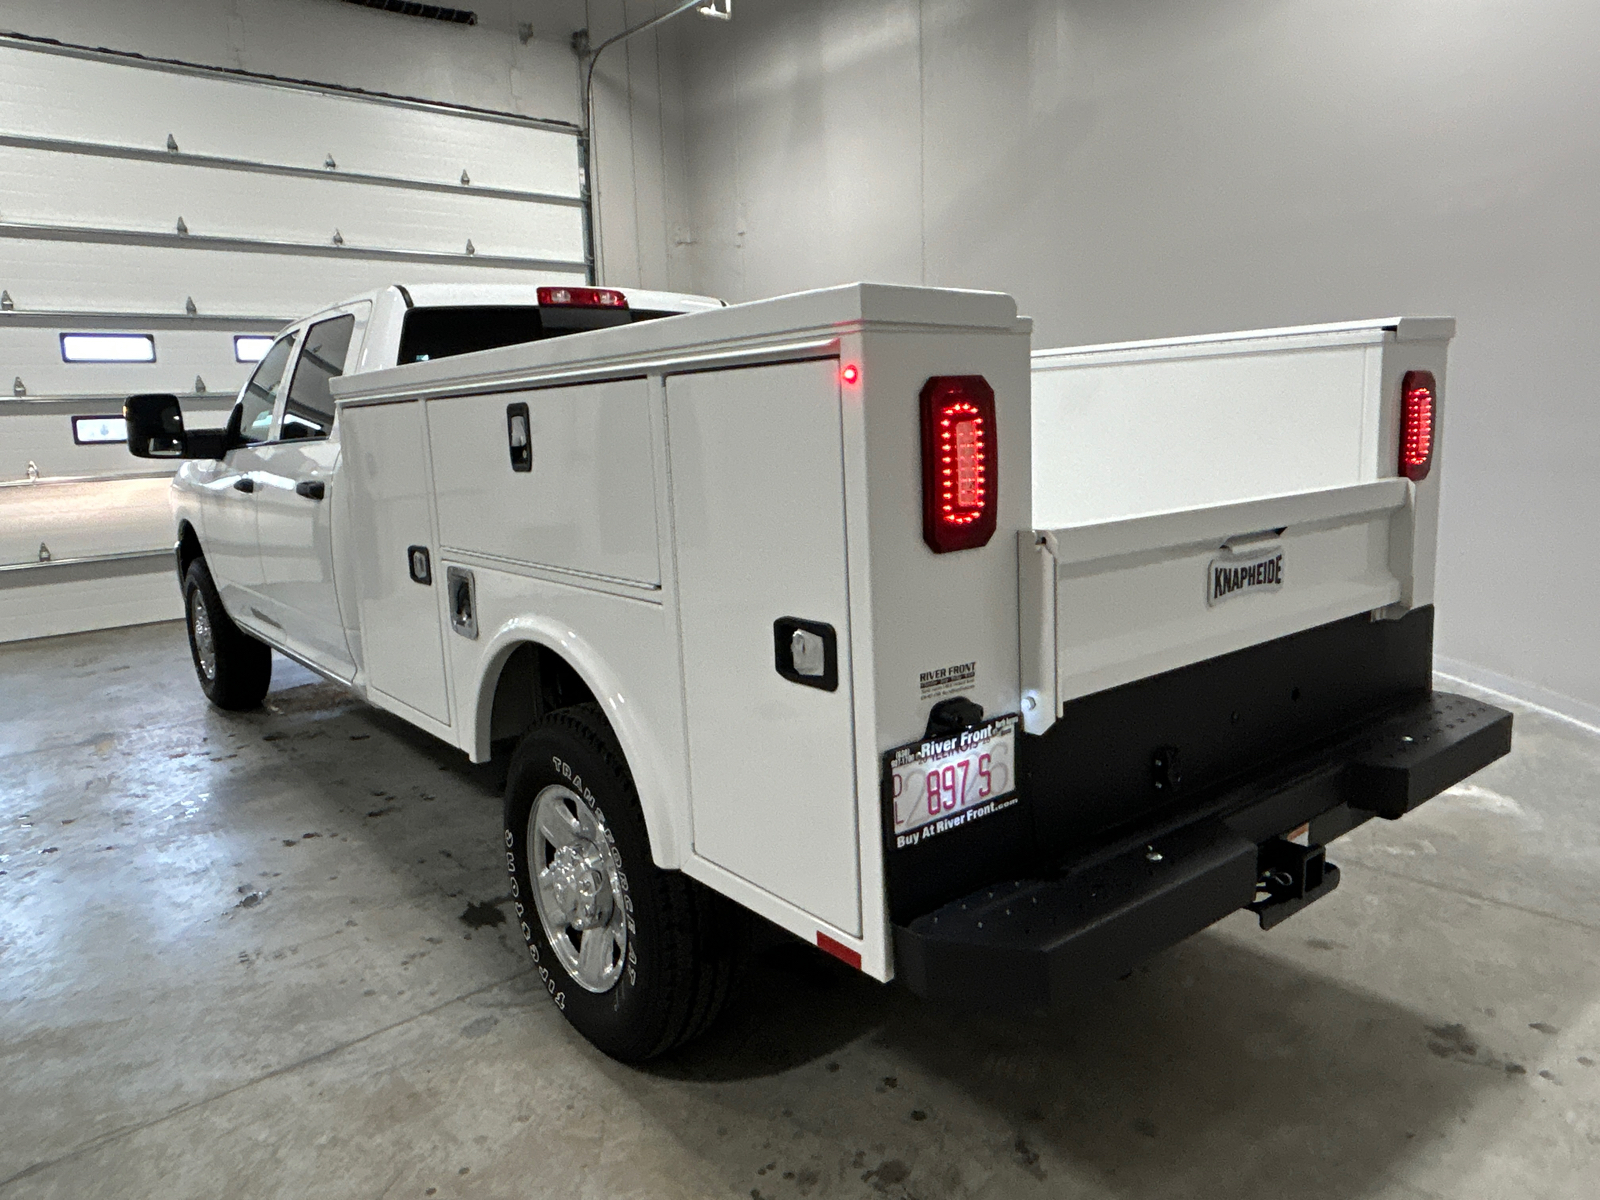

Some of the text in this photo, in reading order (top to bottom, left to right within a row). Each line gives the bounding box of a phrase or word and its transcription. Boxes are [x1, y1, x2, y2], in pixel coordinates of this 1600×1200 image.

[1214, 554, 1282, 599] KNAPHEIDE
[920, 668, 947, 682] RIVER
[948, 661, 976, 676] FRONT
[921, 737, 958, 758] River
[960, 724, 993, 747] Front
[926, 759, 970, 816] 897
[896, 832, 920, 848] Buy
[922, 824, 936, 839] At
[936, 813, 966, 833] River
